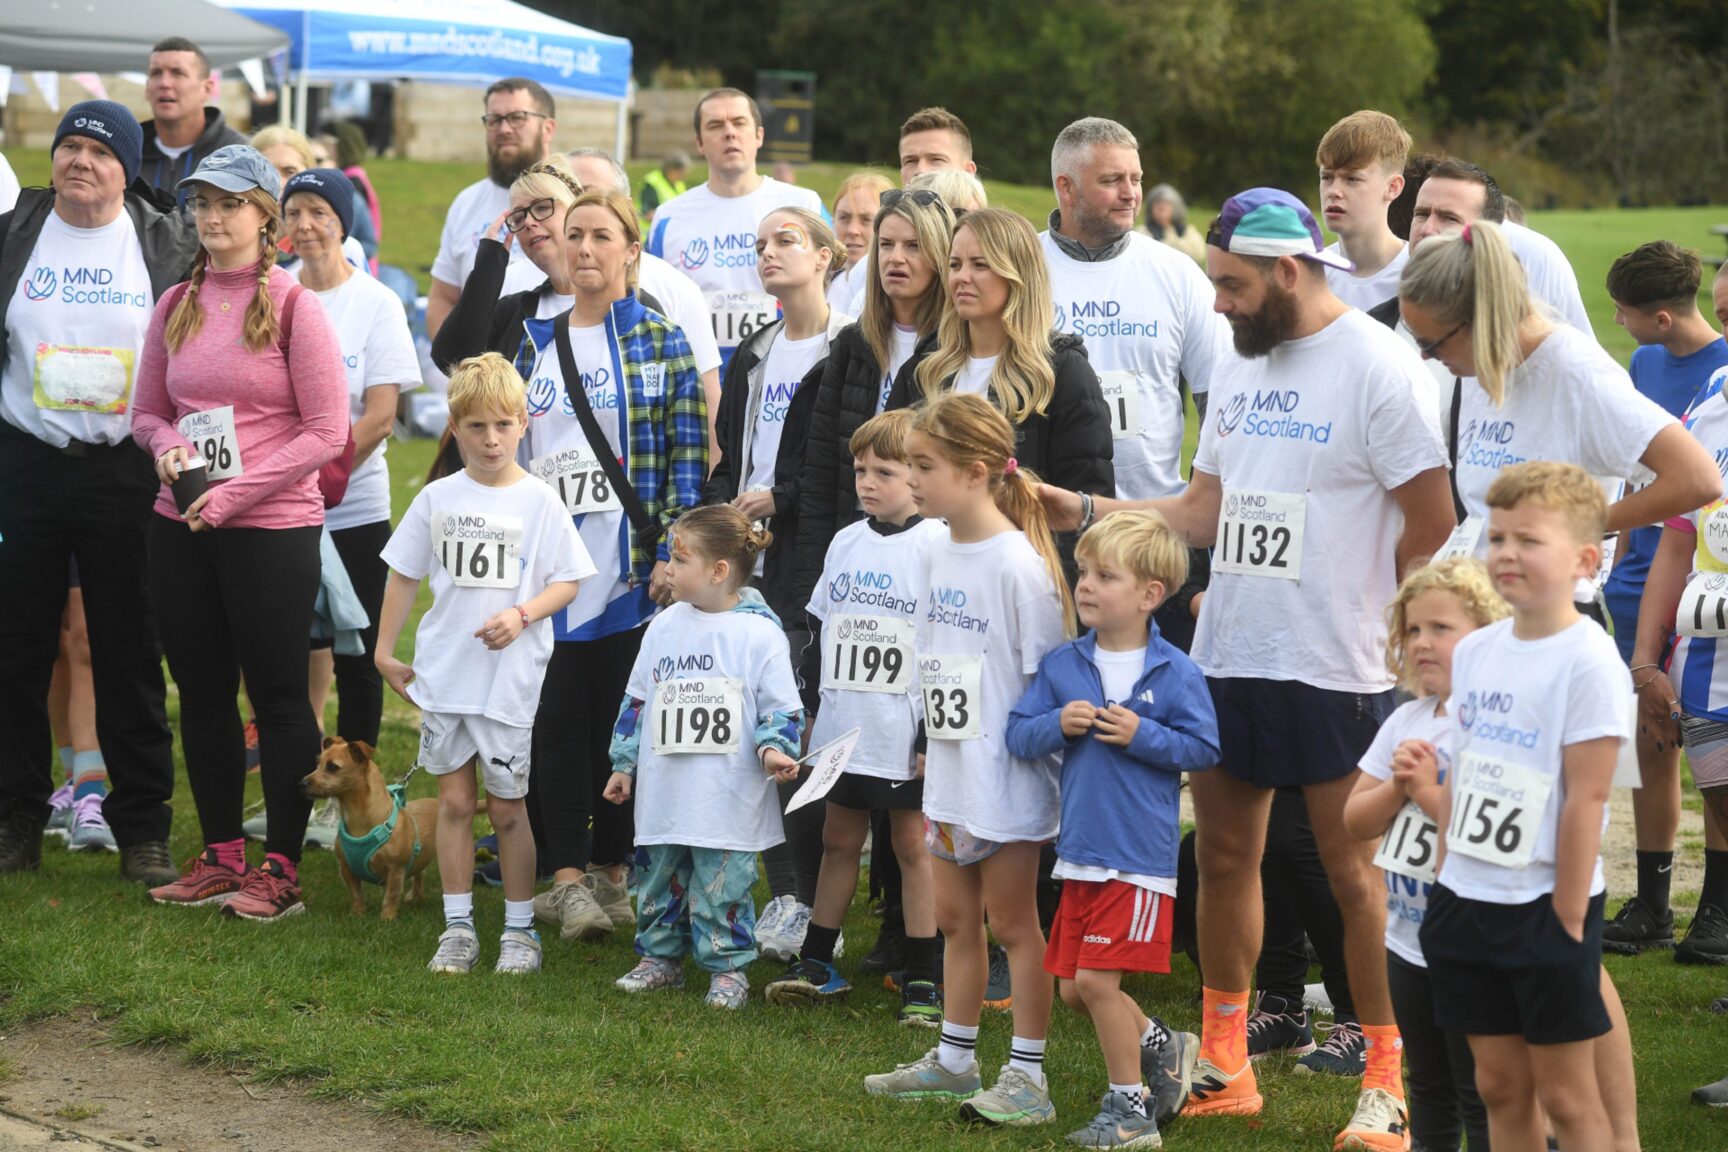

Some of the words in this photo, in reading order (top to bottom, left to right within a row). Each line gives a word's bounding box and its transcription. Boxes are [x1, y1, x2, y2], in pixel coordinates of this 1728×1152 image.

[714, 233, 757, 250] MND
[63, 267, 113, 286] MND
[62, 285, 146, 307] Scotland
[1072, 300, 1121, 318] MND
[1072, 318, 1158, 338] Scotland
[1251, 390, 1300, 413] MND
[192, 414, 211, 427] MND
[1243, 412, 1333, 444] Scotland
[192, 422, 224, 438] Scotland
[556, 450, 580, 463] MND
[1240, 495, 1267, 508] MND
[458, 516, 486, 529] MND
[1240, 506, 1287, 522] Scotland
[457, 527, 505, 541] Scotland
[1222, 522, 1291, 568] 1132
[442, 540, 505, 579] 1161
[854, 570, 893, 590] MND
[849, 587, 918, 614] Scotland
[853, 618, 879, 631] MND
[936, 604, 989, 634] Scotland
[852, 630, 898, 645] Scotland
[677, 654, 714, 671] MND
[834, 643, 903, 684] 1199
[678, 681, 705, 693] MND
[678, 693, 725, 704] Scotland
[661, 706, 732, 745] 1198
[1450, 791, 1523, 854] 1156
[1083, 934, 1112, 945] adidas
